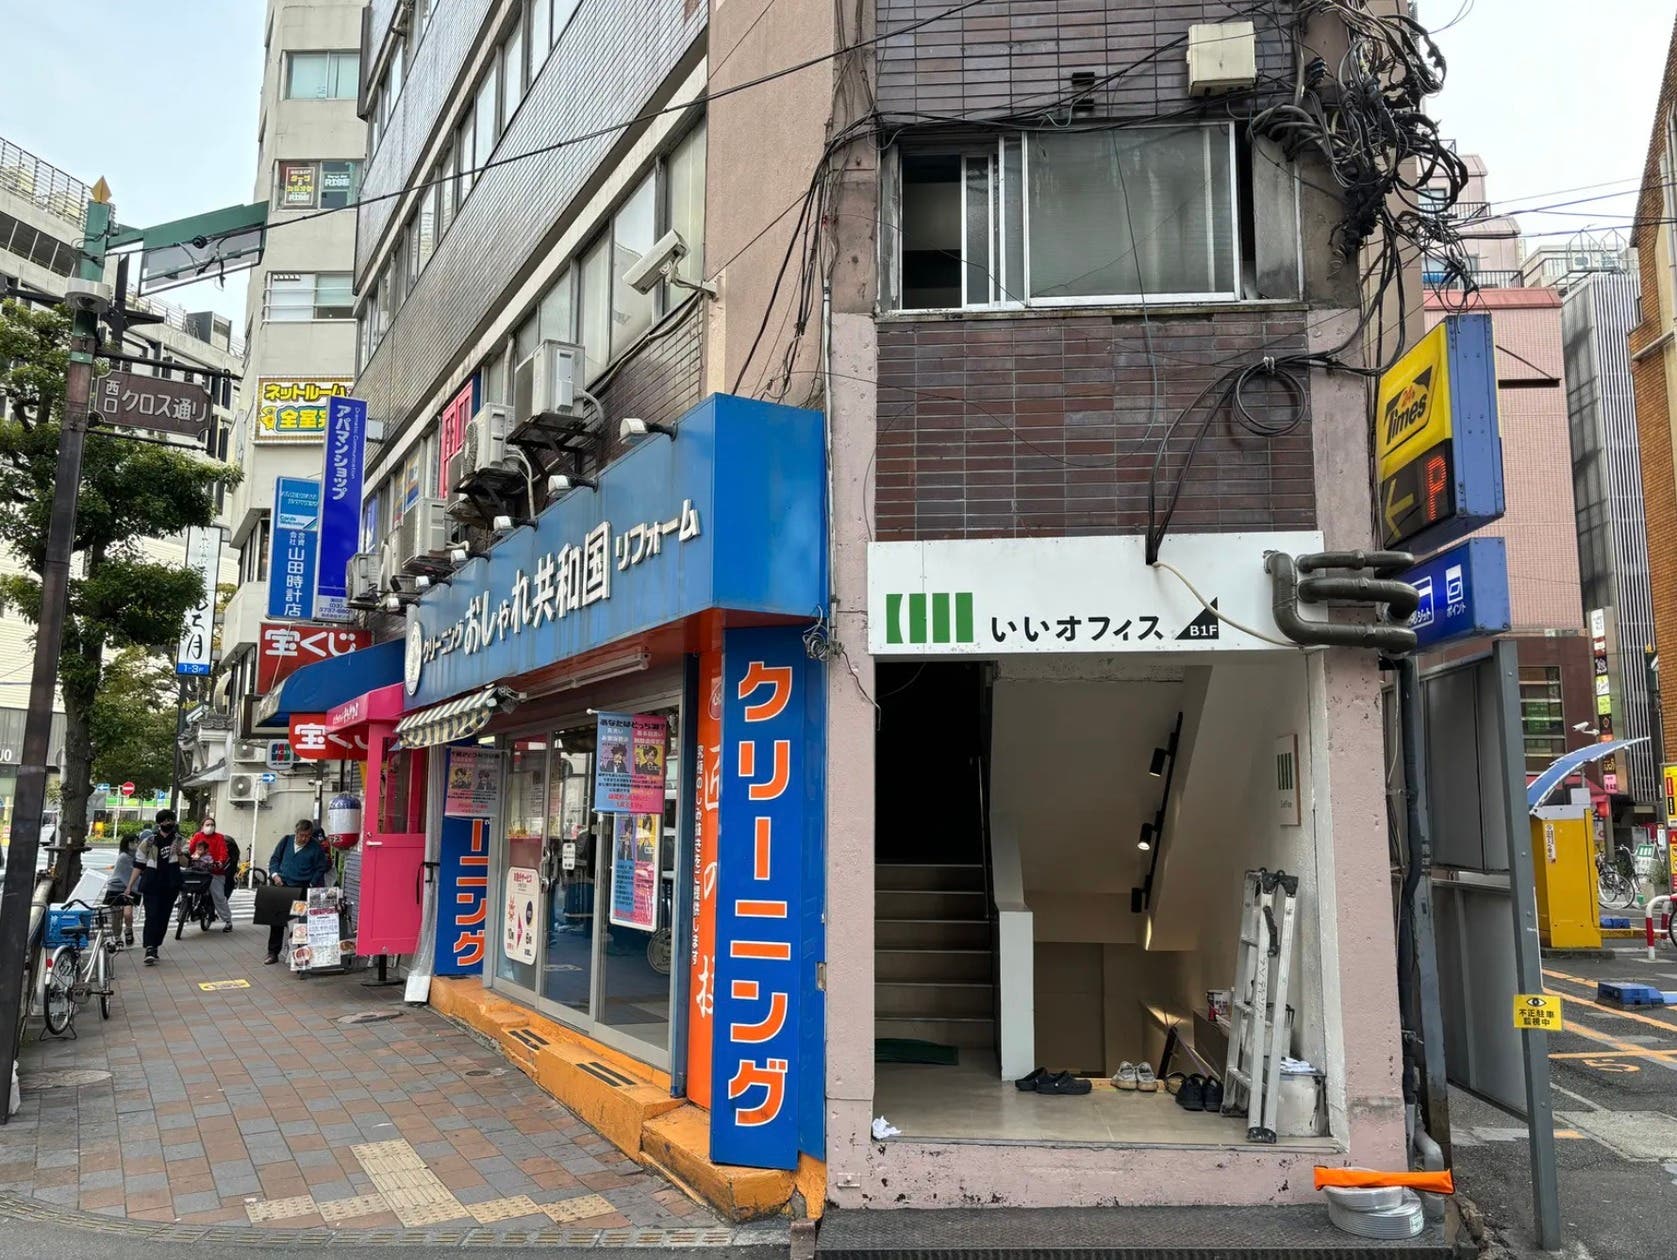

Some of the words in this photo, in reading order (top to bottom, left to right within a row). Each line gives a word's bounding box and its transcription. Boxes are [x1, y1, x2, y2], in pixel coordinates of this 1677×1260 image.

[104, 380, 120, 413] 西口
[122, 390, 207, 422] クロス通り
[265, 384, 347, 401] ネットルーム
[1385, 394, 1427, 445] Times
[332, 405, 351, 500] アパマンショップ
[1427, 456, 1447, 521] P
[284, 547, 305, 616] 山田時計店
[423, 620, 464, 663] クリーニング
[464, 521, 611, 656] おしゃれ共和国
[615, 499, 700, 571] リフォーム
[991, 615, 1164, 641] いいオフィス
[1190, 624, 1219, 637] B1F
[1447, 602, 1466, 617] ポイント
[265, 629, 357, 657] 宝くじ
[730, 661, 793, 1127] クリーニング
